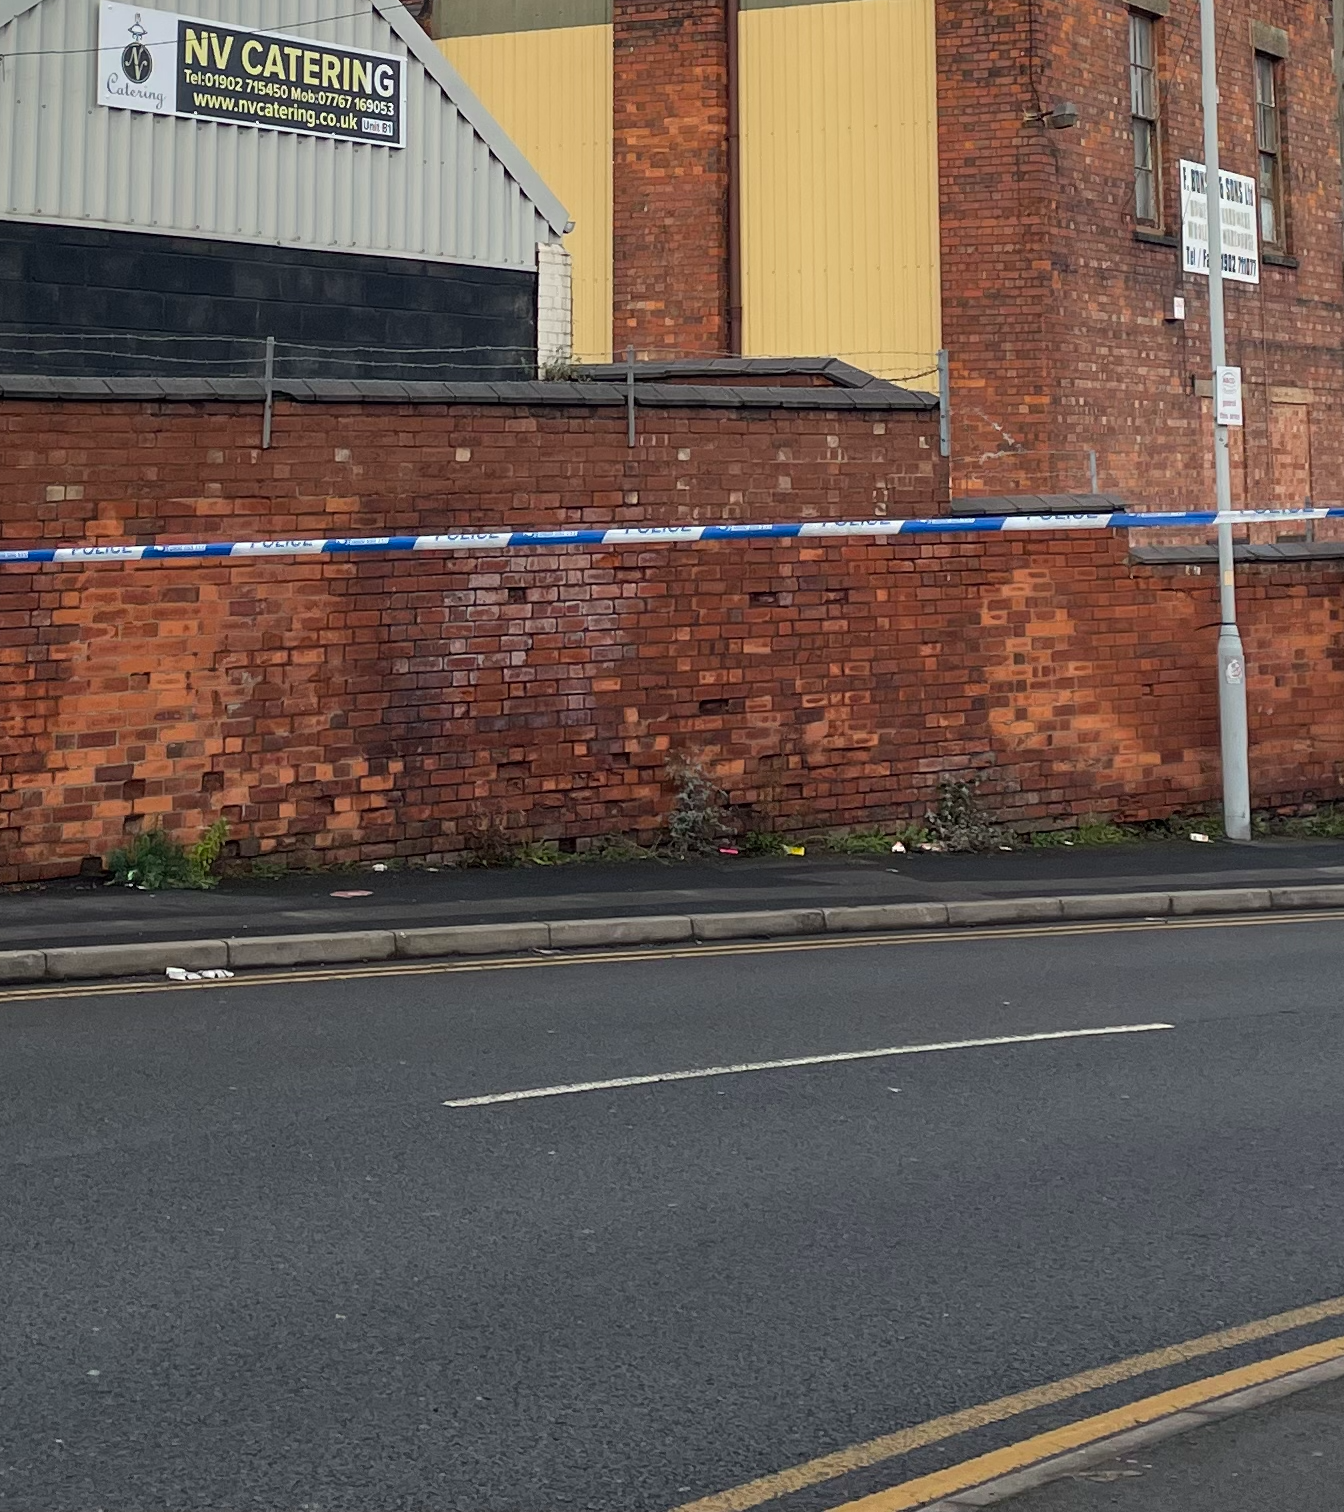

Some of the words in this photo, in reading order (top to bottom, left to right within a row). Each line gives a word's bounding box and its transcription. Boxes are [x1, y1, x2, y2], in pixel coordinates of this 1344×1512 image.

[185, 28, 234, 70] NV
[241, 39, 394, 98] CATERING
[107, 72, 166, 110] Catering
[183, 68, 243, 92] Tel:01902
[245, 78, 289, 99] 715450
[291, 86, 352, 109] Mob:07767
[354, 96, 394, 116] 169053
[193, 91, 358, 130] www.nvcatering.co.uk
